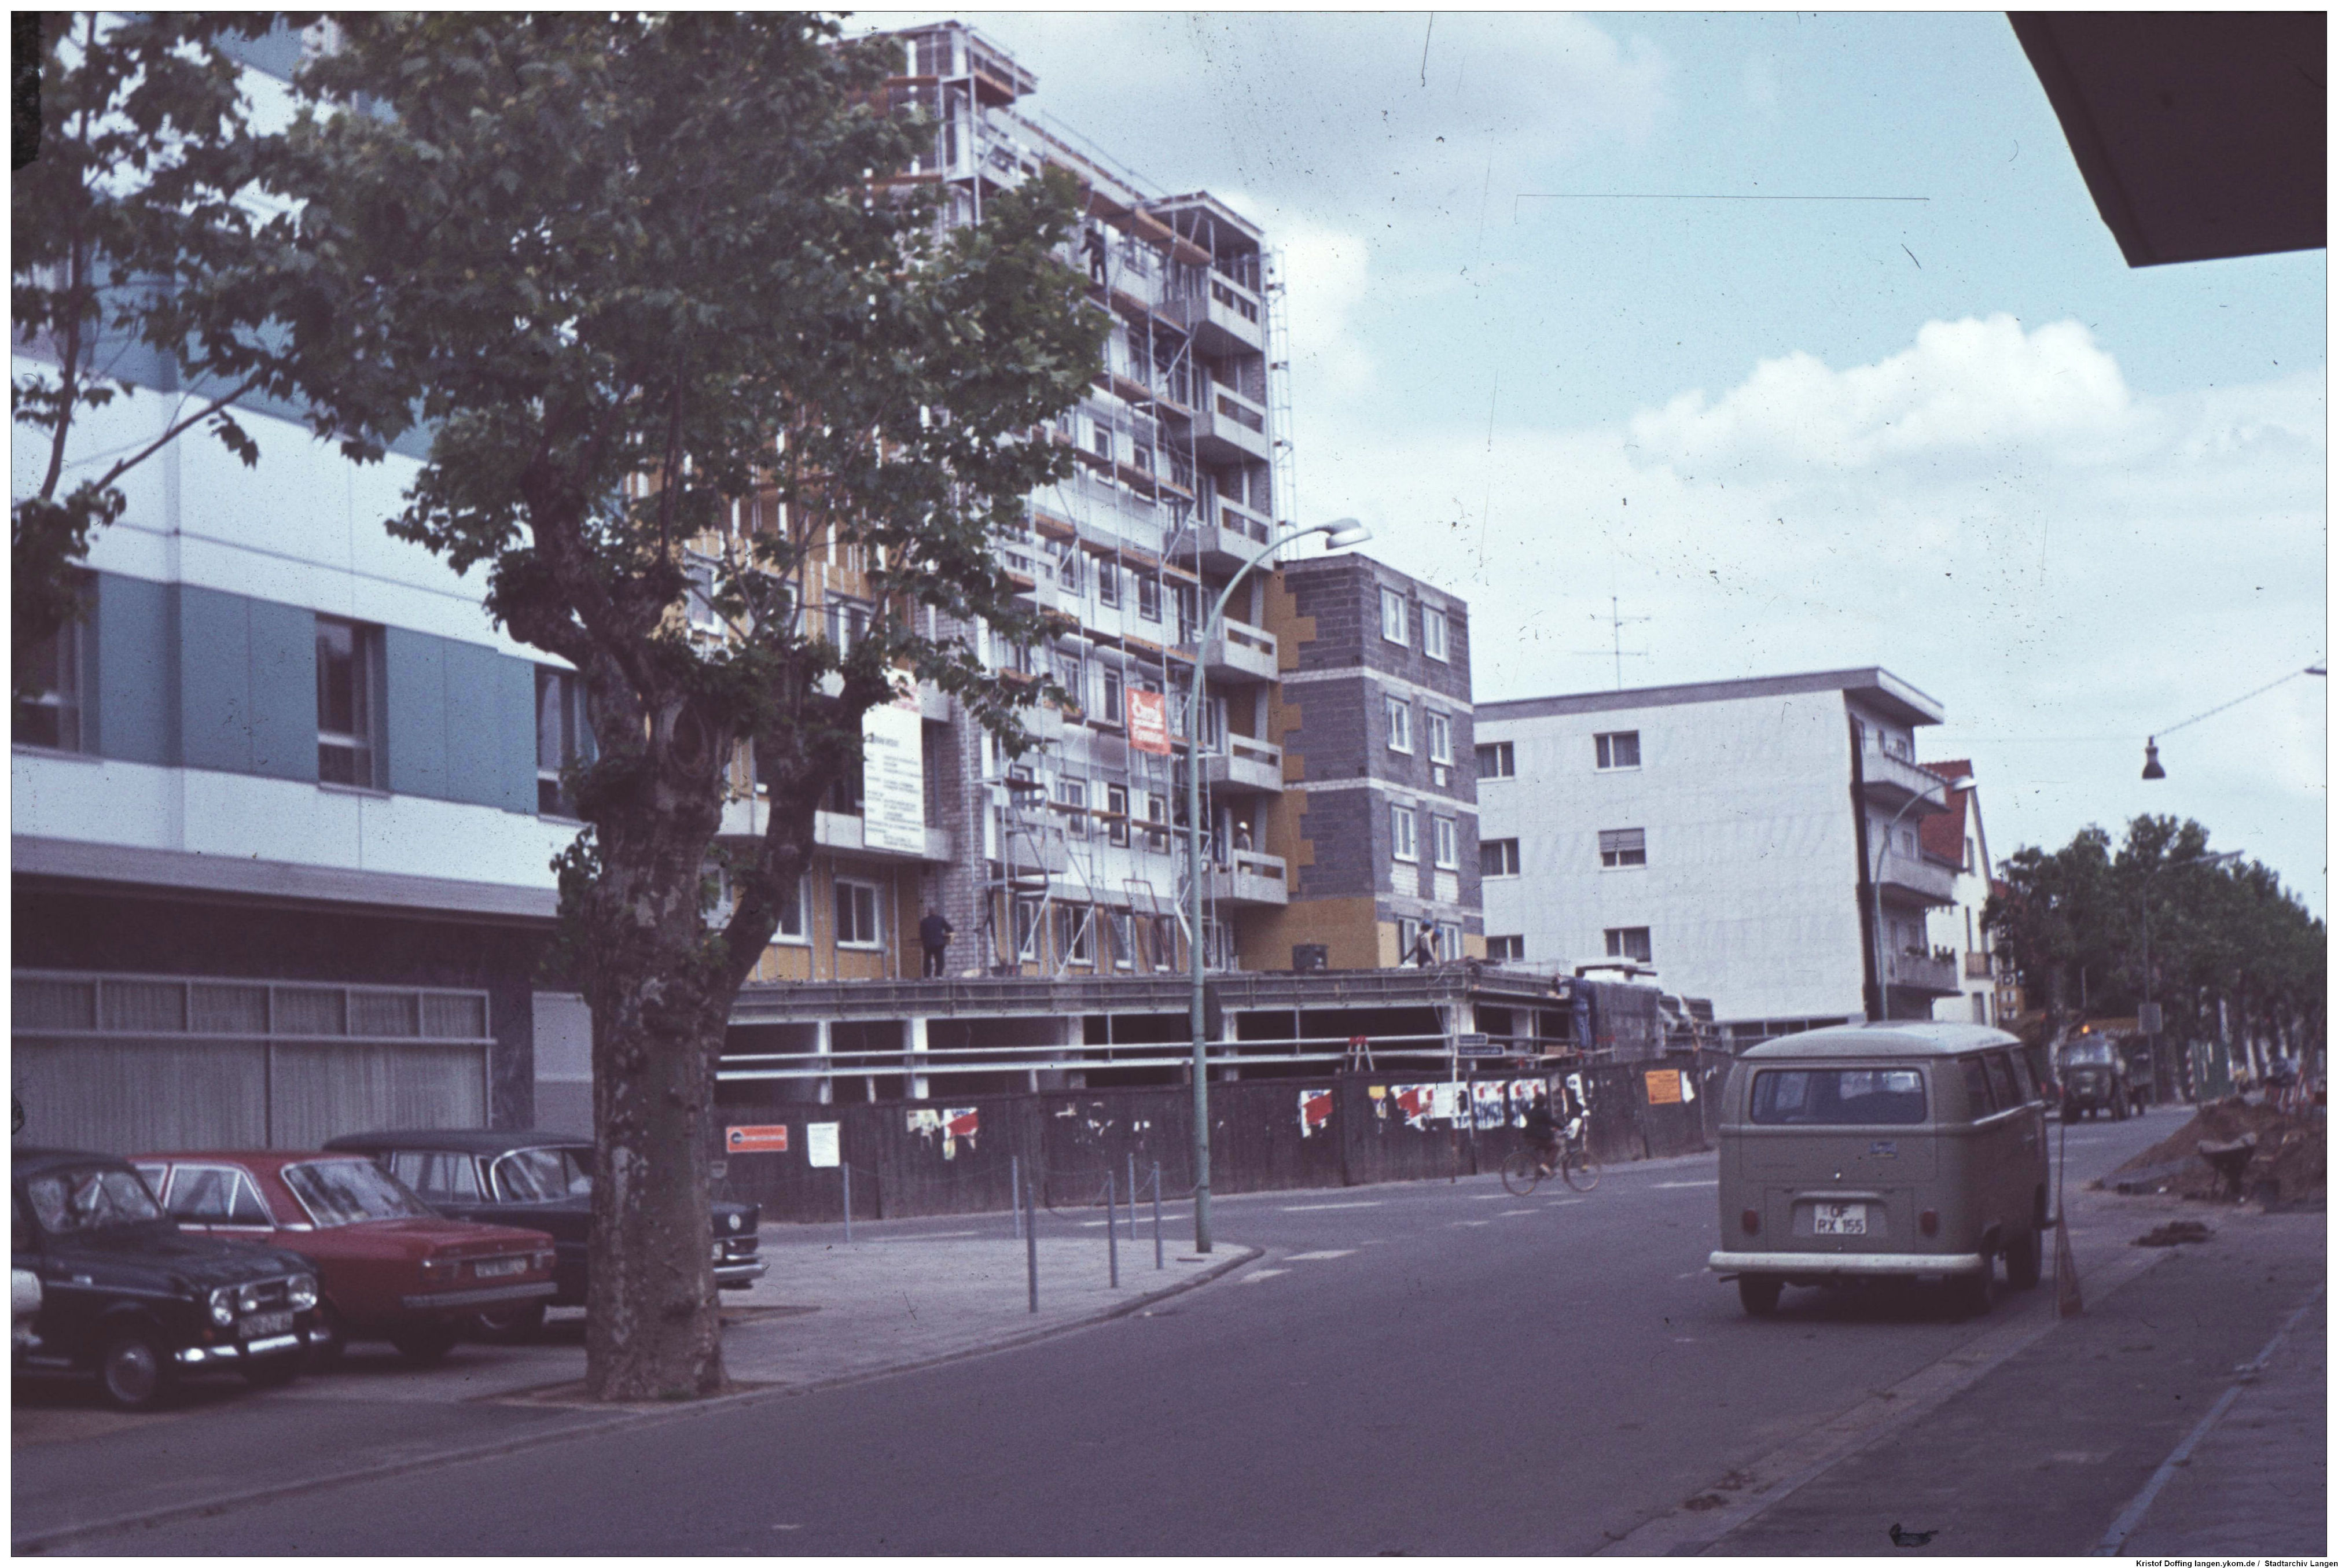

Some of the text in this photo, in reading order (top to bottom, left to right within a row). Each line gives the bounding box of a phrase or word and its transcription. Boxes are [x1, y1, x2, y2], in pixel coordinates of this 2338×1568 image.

[1830, 1205, 1850, 1219] OF
[1817, 1219, 1863, 1233] RX 155
